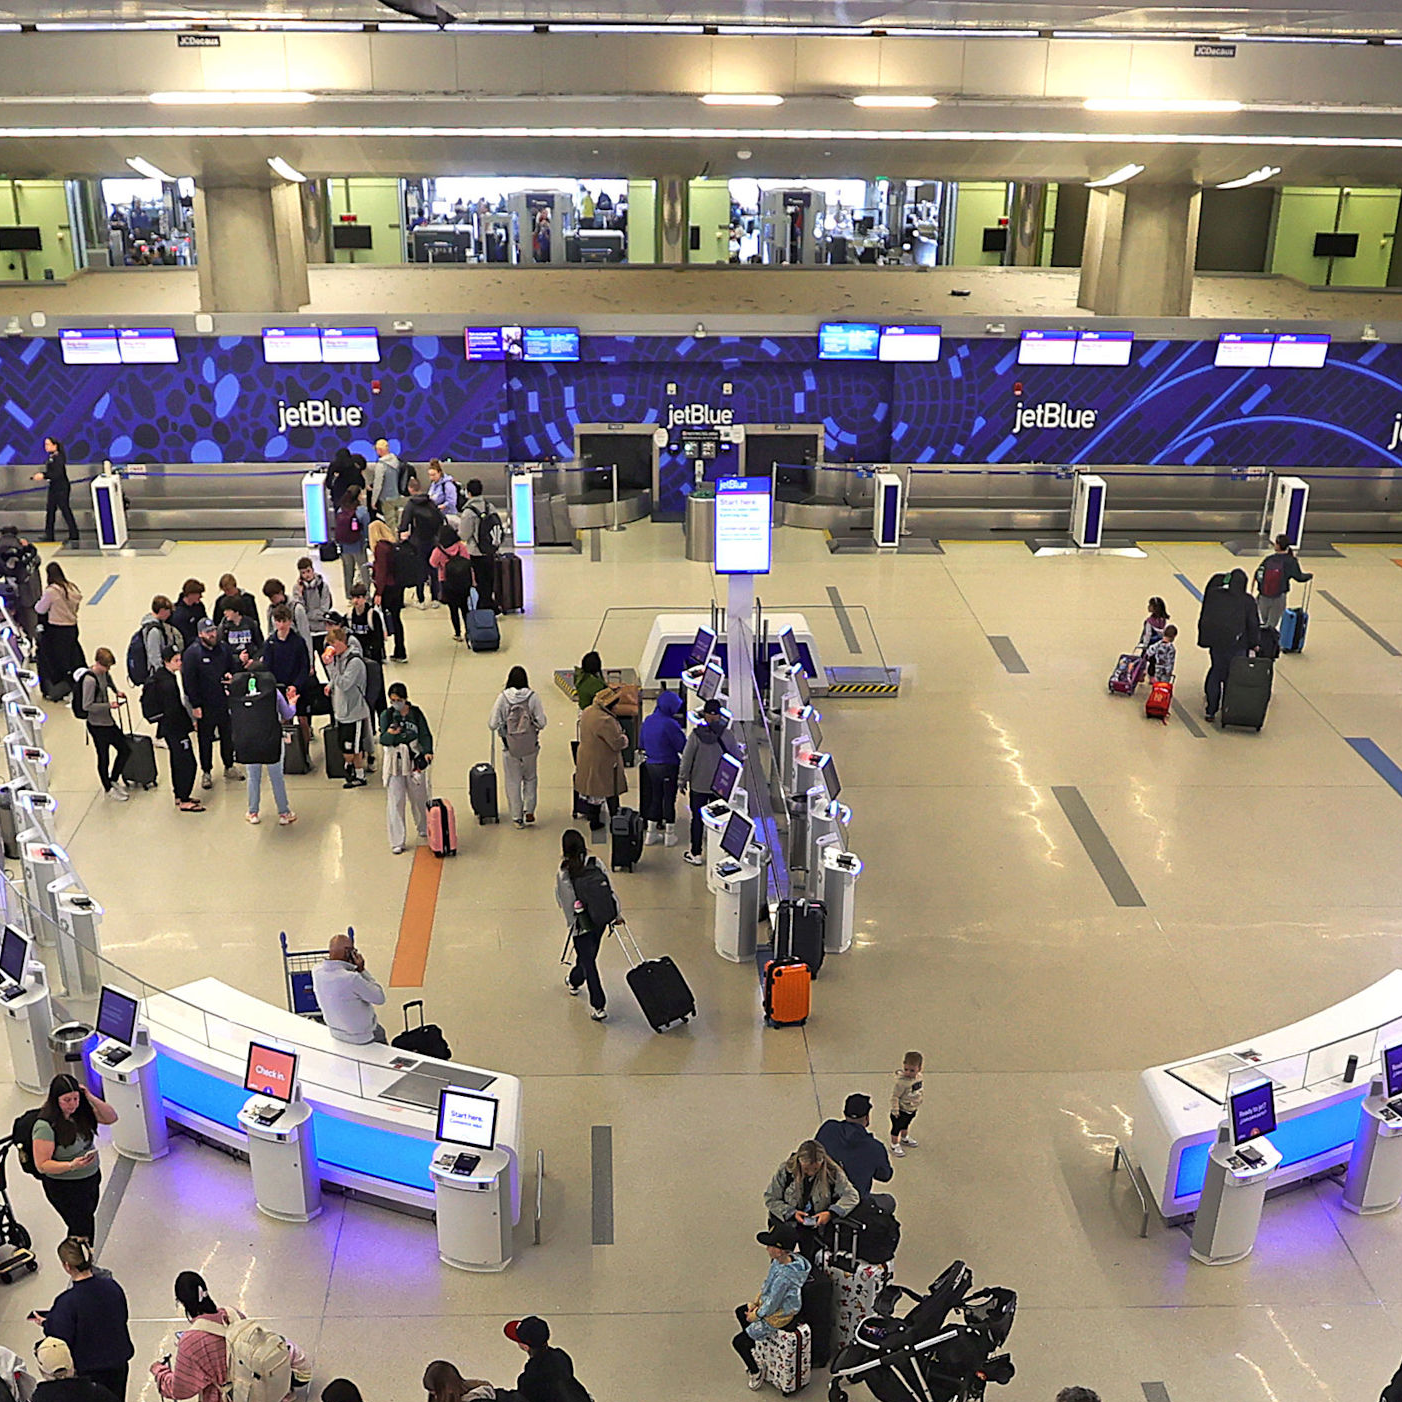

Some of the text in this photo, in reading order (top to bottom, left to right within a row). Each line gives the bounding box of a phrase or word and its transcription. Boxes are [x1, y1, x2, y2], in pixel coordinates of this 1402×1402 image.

[278, 400, 363, 432] jetBlue
[667, 404, 734, 429] jetBlue
[1012, 402, 1098, 433] jetBlue
[254, 1064, 277, 1079] Check
[450, 1110, 467, 1120] Start
